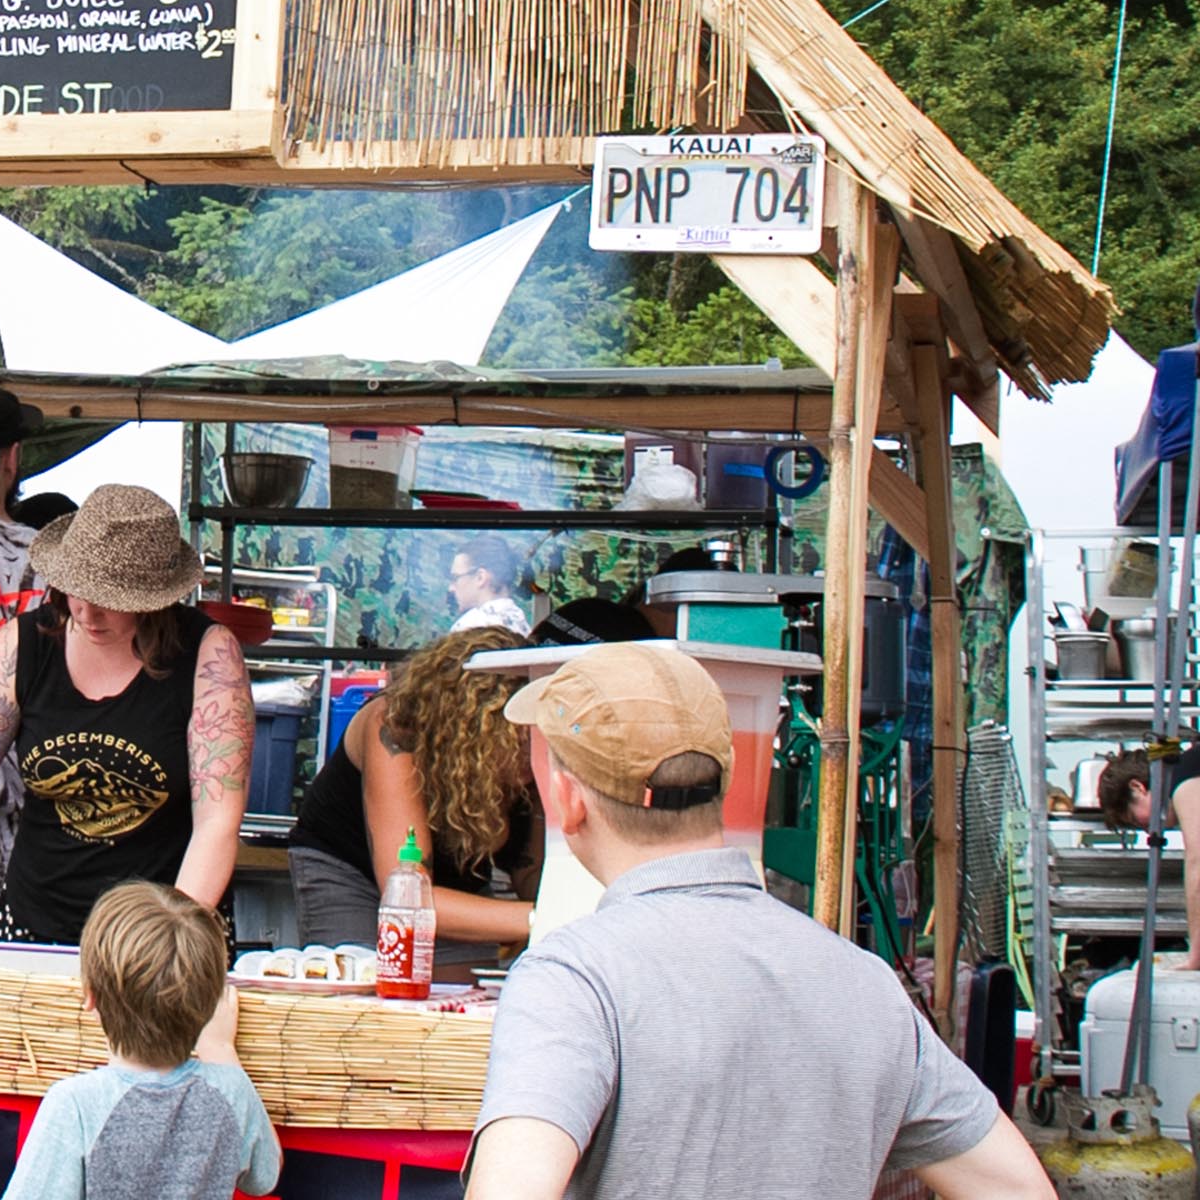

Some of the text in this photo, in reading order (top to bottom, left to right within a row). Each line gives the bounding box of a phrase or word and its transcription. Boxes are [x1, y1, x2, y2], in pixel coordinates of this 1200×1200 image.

[57, 33, 136, 54] MINERAL
[139, 31, 196, 50] WATER
[670, 138, 751, 153] KAUAI
[606, 167, 809, 224] PNP 704
[22, 732, 168, 782] THE DECEMBERISTS
